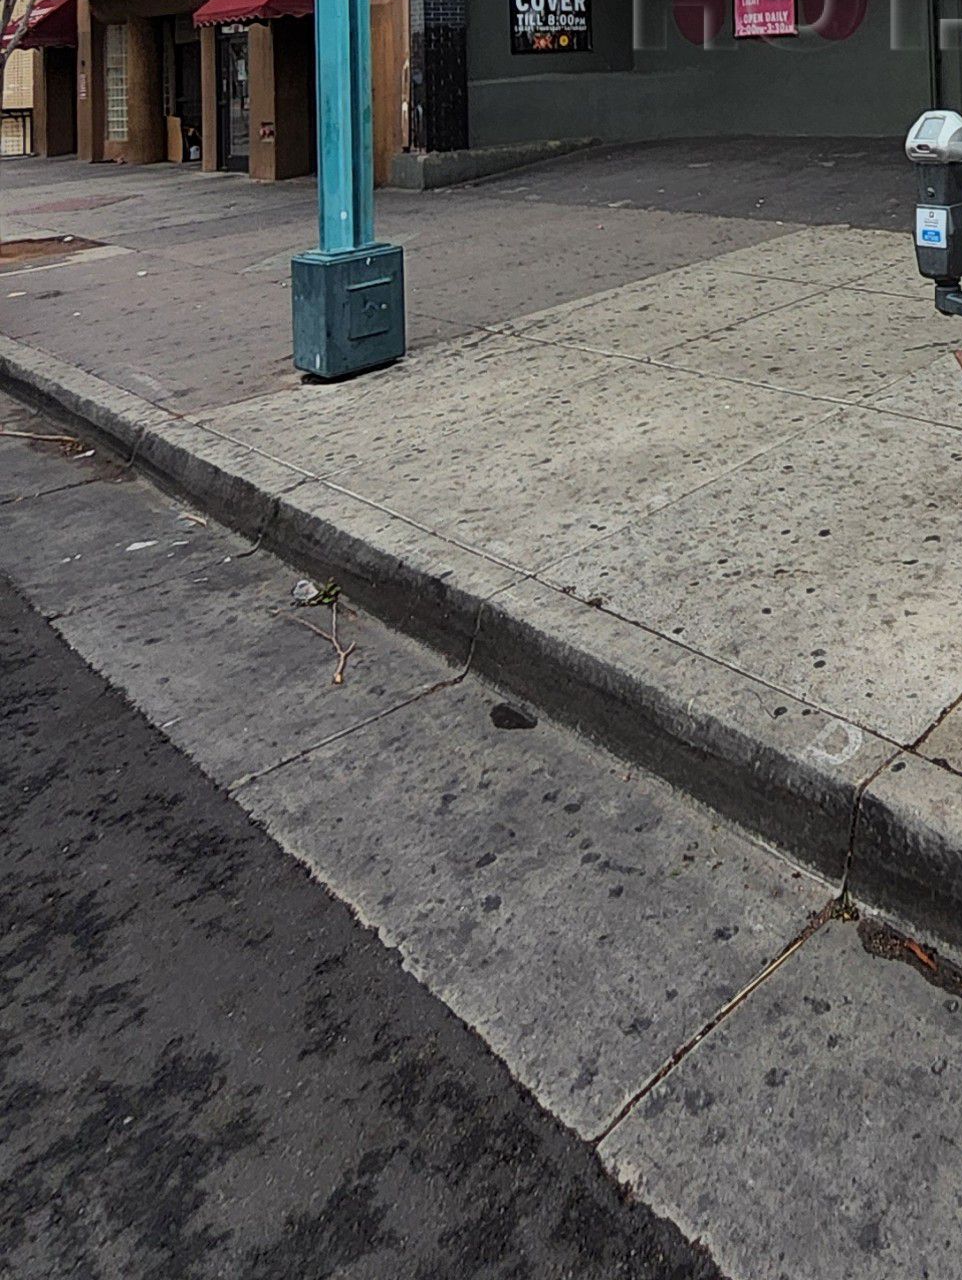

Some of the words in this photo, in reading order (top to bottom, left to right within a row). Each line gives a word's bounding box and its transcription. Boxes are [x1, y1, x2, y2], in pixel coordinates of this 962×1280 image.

[516, 13, 544, 26] TILL
[743, 12, 764, 25] OPEN
[764, 10, 789, 22] DAILY
